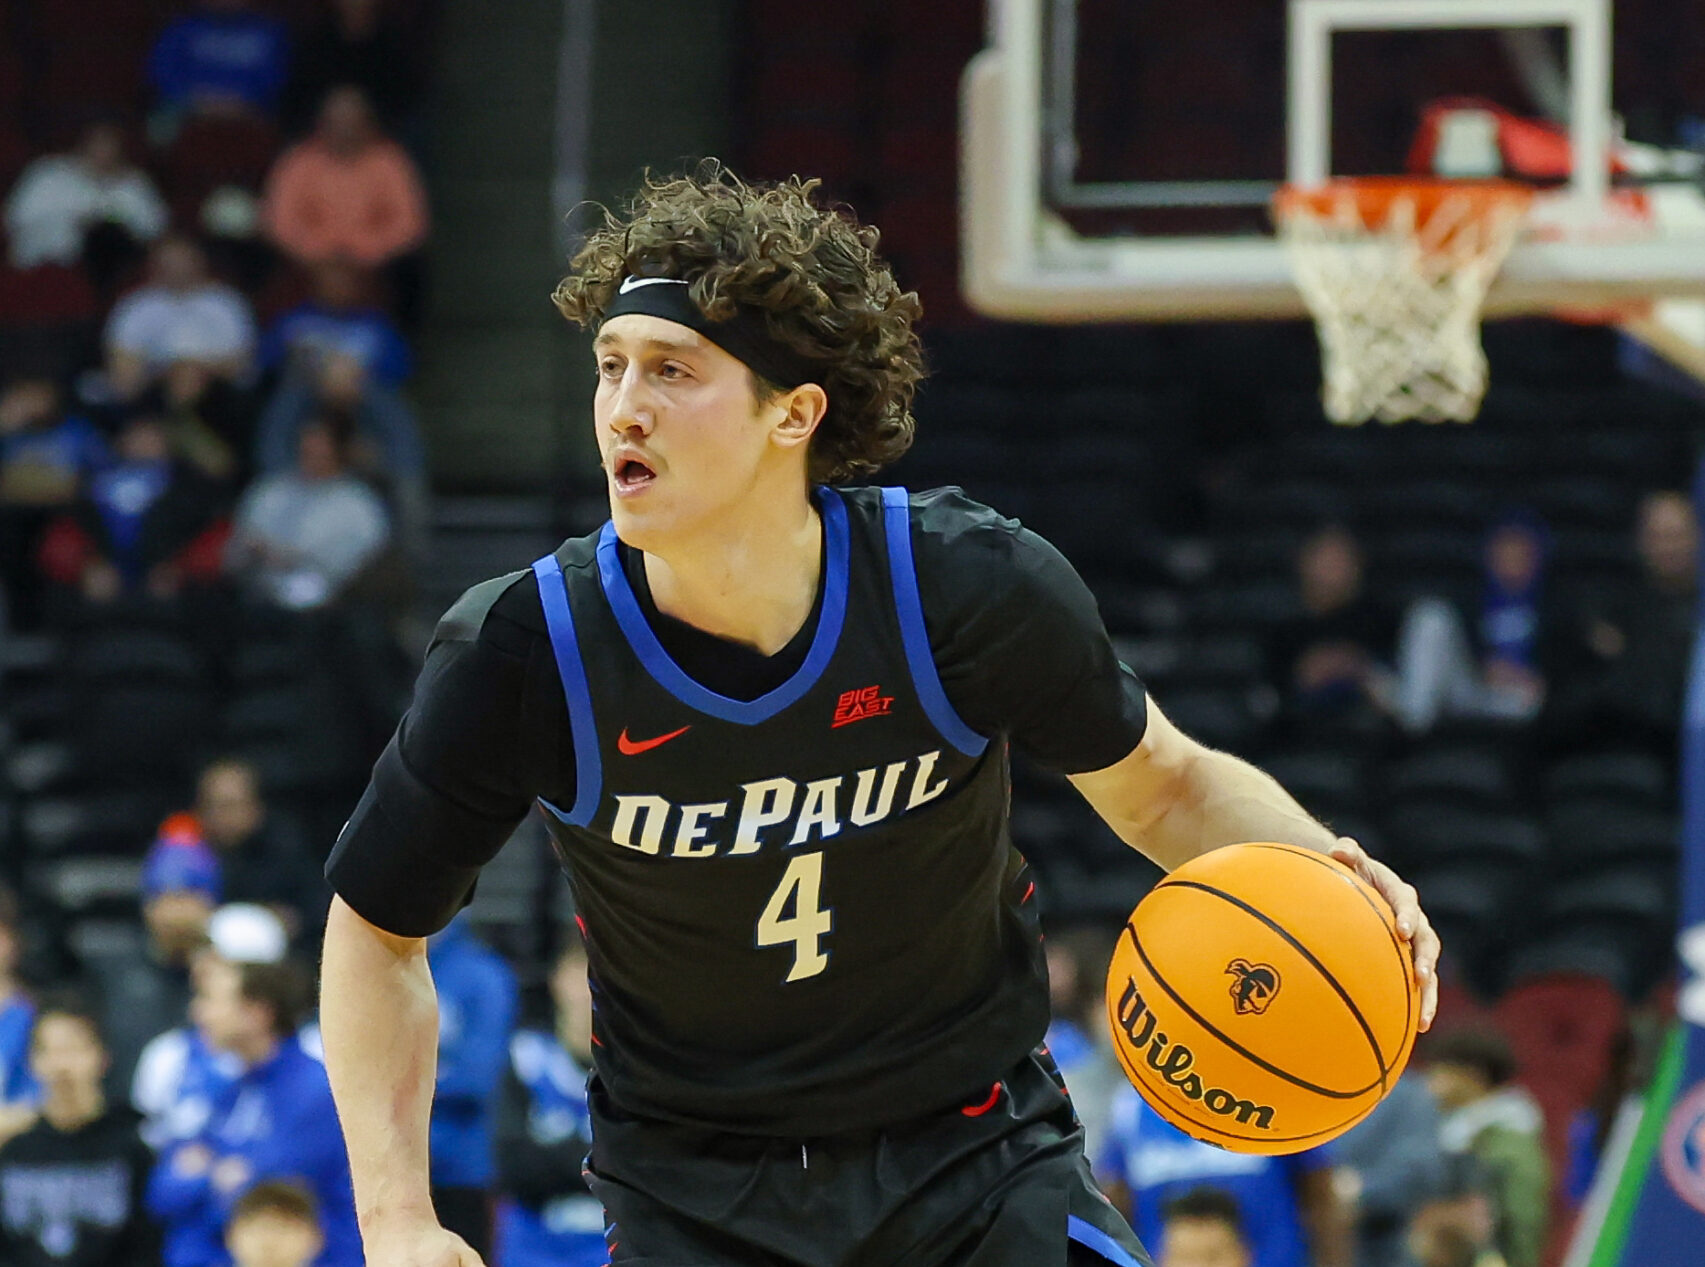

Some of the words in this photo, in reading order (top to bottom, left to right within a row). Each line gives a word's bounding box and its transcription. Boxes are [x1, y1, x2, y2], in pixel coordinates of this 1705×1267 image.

[834, 697, 895, 721] EAST
[839, 685, 880, 706] BIG
[756, 850, 832, 984] 4
[1118, 975, 1275, 1129] Wilson
